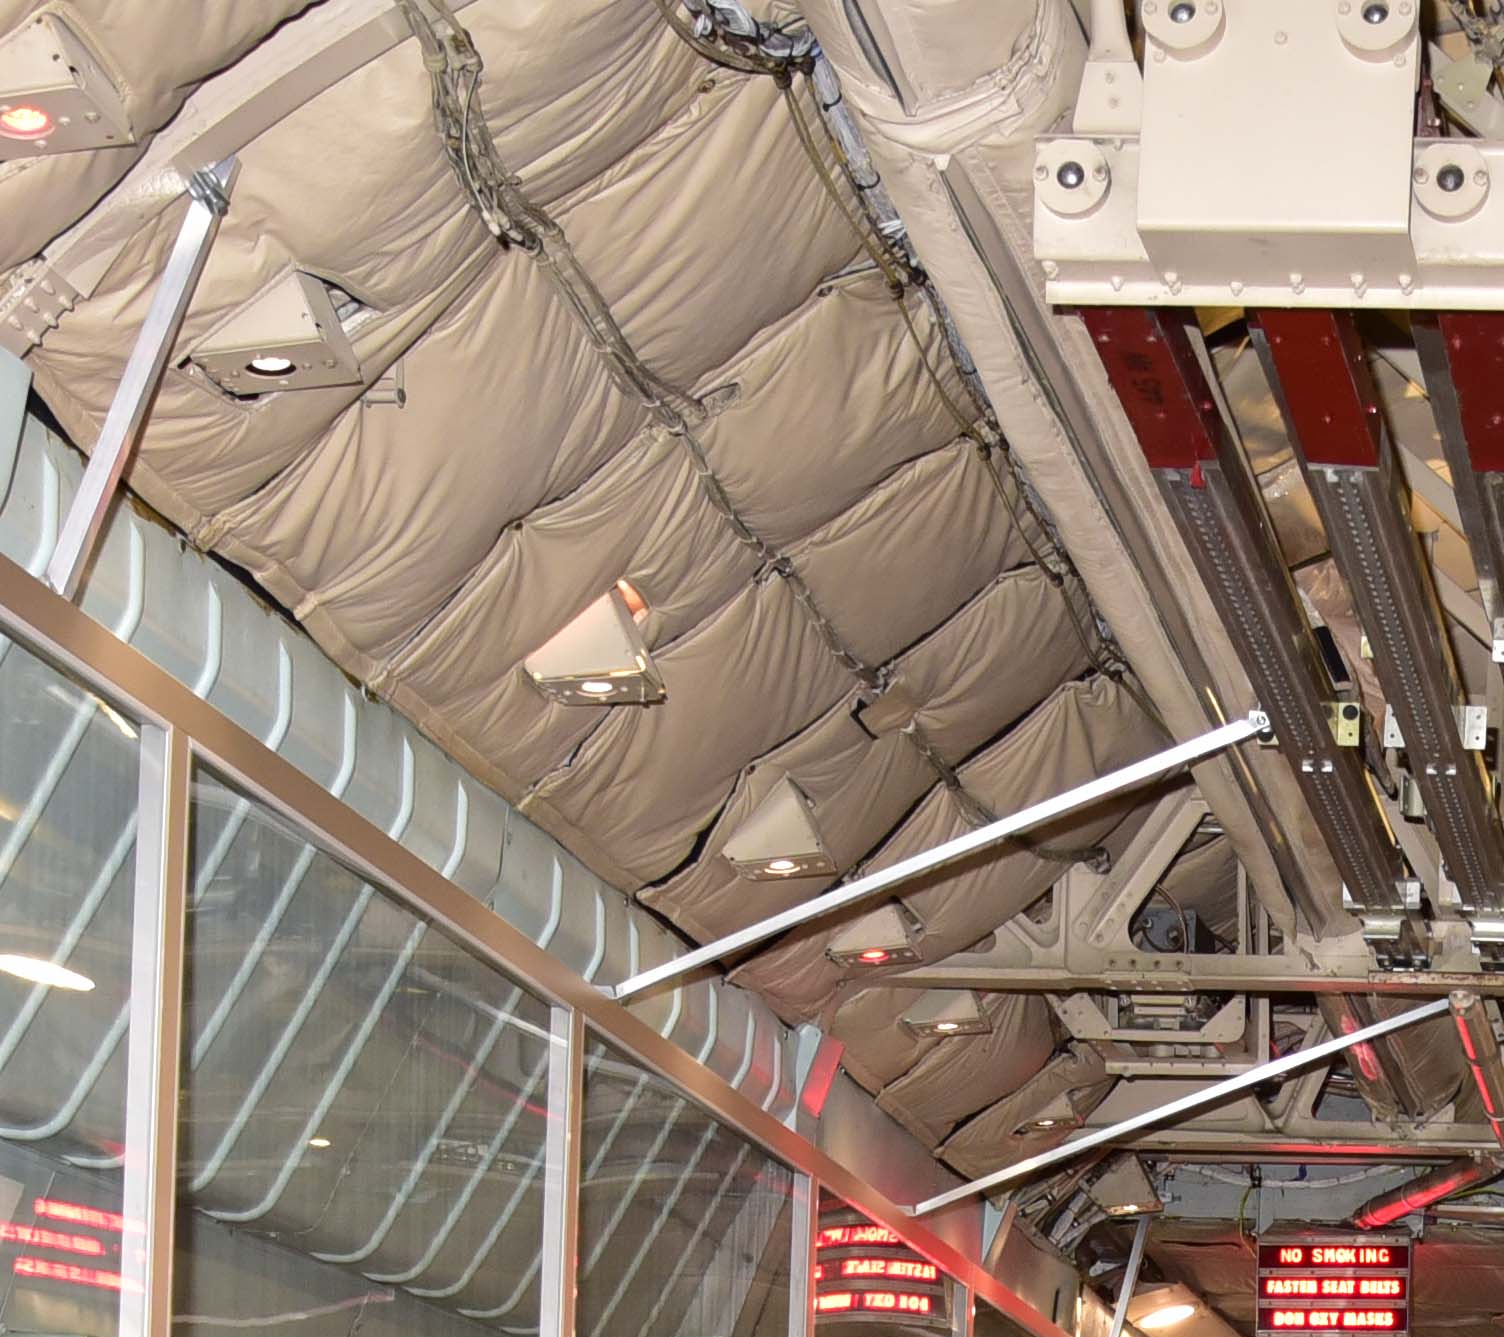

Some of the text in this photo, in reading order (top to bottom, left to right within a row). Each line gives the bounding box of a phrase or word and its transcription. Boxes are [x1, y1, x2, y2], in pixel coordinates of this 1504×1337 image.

[1279, 1247, 1391, 1263] NO SMOKING
[1266, 1279, 1401, 1295] FASTEN SEAT BELTS
[1273, 1311, 1394, 1327] DON OXY MASKS
